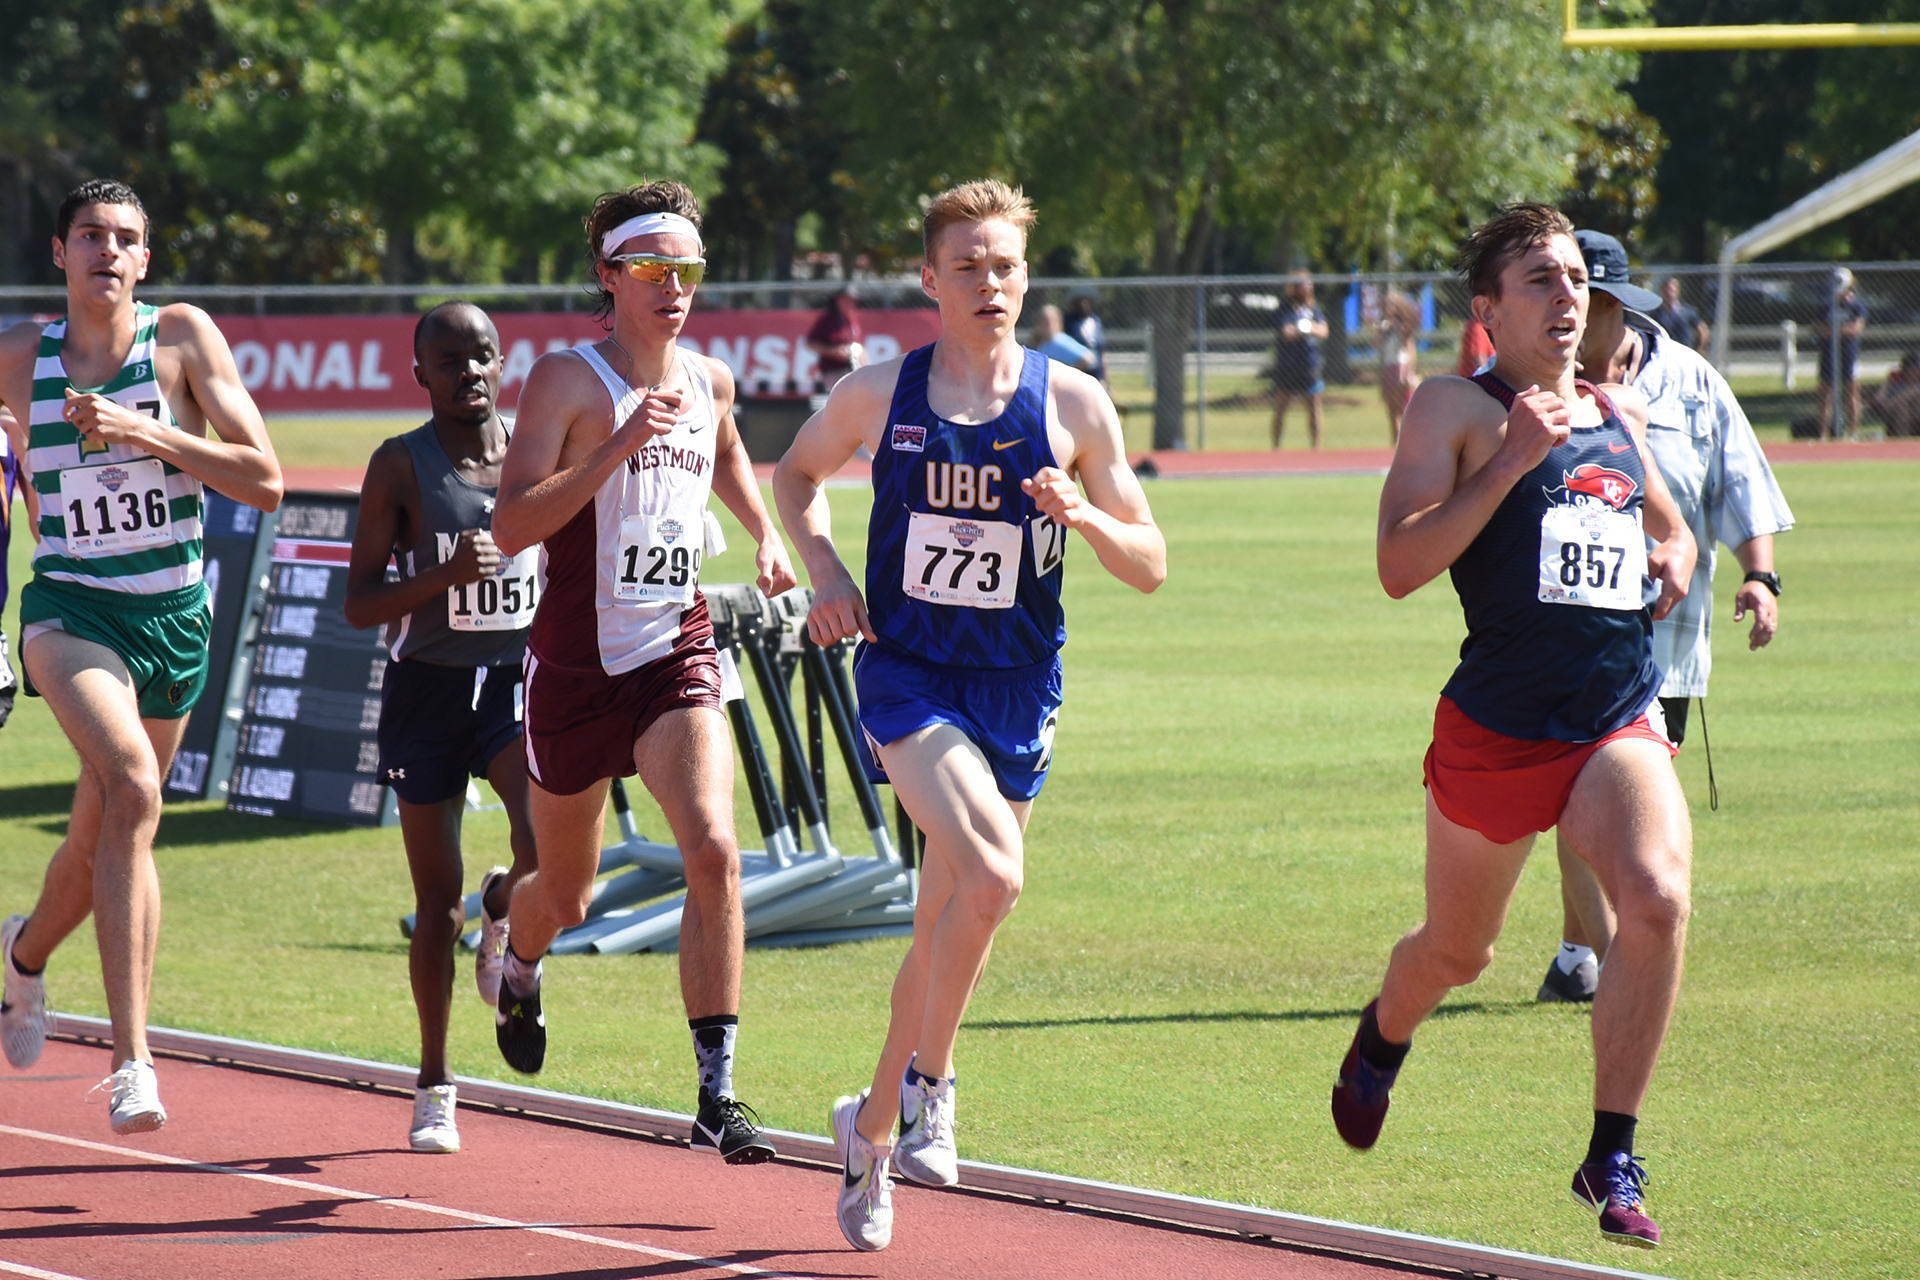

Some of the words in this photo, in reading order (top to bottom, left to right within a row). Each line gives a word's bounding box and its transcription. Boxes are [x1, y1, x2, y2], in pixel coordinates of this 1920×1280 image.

[231, 339, 393, 391] ONAL
[626, 444, 710, 477] WESTMON
[926, 461, 1002, 511] UBC
[69, 488, 166, 538] 1136
[435, 532, 459, 564] M
[620, 545, 700, 587] 1299
[1041, 516, 1057, 572] 2
[1560, 542, 1626, 589] 857
[921, 544, 1003, 592] 773
[454, 575, 536, 616] 1051
